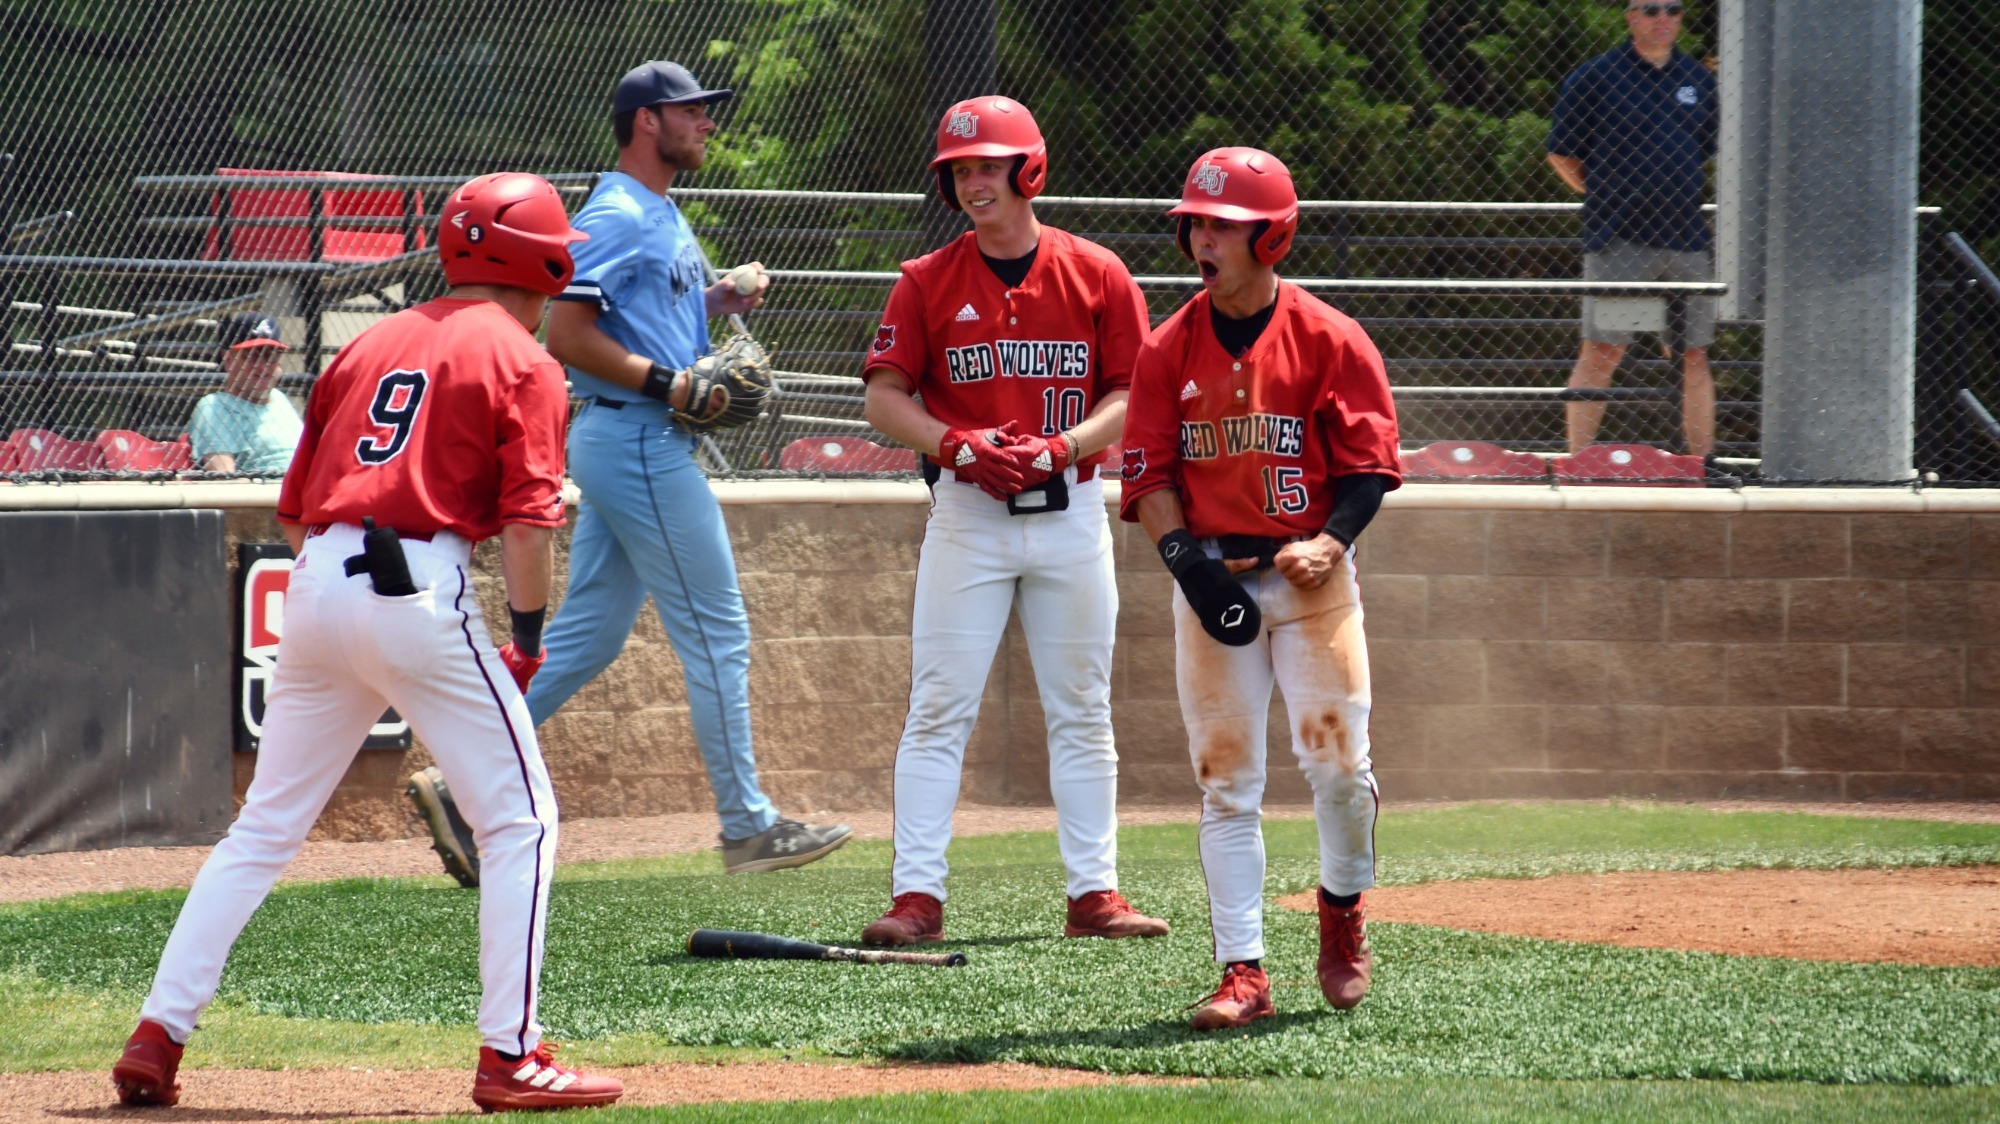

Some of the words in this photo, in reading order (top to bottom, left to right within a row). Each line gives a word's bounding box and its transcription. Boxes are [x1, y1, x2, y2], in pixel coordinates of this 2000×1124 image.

[470, 227, 479, 241] 9
[955, 313, 980, 321] adidas
[946, 343, 996, 383] RED
[996, 340, 1089, 378] WOLVES
[354, 368, 430, 466] 9
[1042, 386, 1086, 435] 10
[1181, 420, 1219, 460] RED
[1221, 412, 1304, 457] WOLVES
[1260, 465, 1309, 516] 15
